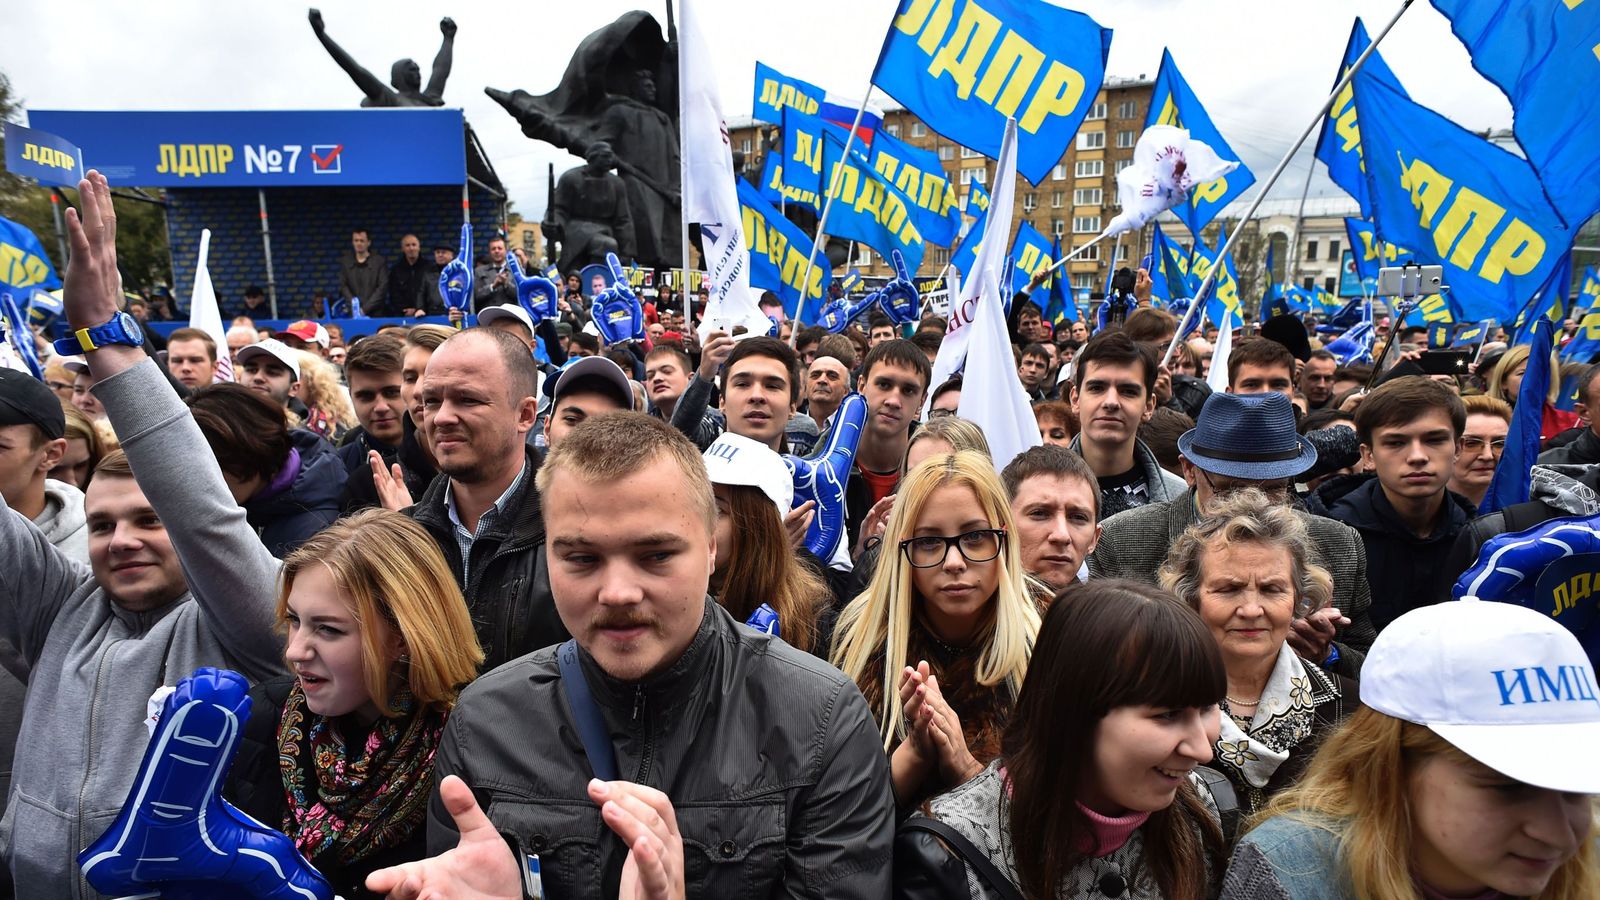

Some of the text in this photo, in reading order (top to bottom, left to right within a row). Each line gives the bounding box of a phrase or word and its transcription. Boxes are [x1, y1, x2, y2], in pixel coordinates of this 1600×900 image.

[894, 0, 1086, 135] ЛДПР
[759, 78, 819, 115] ЛДПР
[21, 143, 75, 171] ЛДПР
[156, 144, 234, 177] ЛДПР
[1397, 149, 1547, 285] ДПР
[704, 443, 740, 465] МЦ
[1490, 665, 1600, 706] ИМЦ
